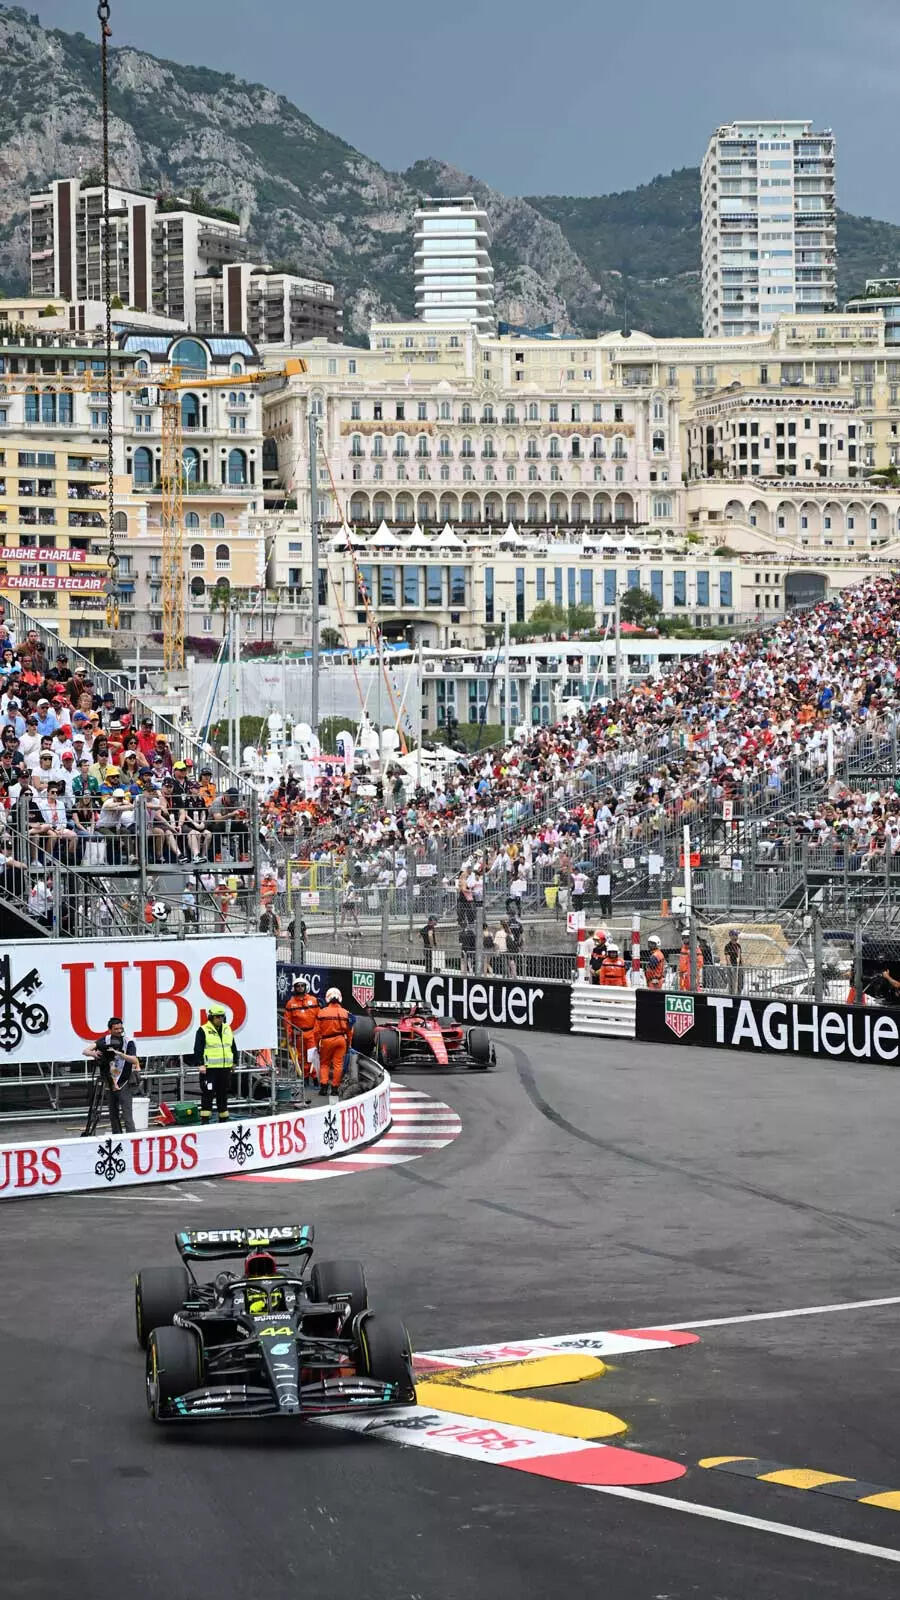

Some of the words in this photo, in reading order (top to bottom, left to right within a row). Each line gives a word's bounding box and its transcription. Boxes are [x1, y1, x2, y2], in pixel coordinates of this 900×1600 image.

[2, 548, 37, 559] DAGHE
[38, 549, 82, 560] CHARLIE
[7, 577, 56, 588] CHARLES
[57, 578, 101, 589] L'ECLAIR
[354, 973, 373, 986] TAG
[61, 956, 246, 1040] UBS
[667, 997, 692, 1012] TAG
[666, 1013, 692, 1035] HEUER
[340, 1103, 365, 1143] UBS
[257, 1117, 307, 1159] UBS
[131, 1132, 198, 1176] UBS
[197, 1226, 293, 1242] PETRONAS
[259, 1326, 294, 1337] 44
[426, 1424, 537, 1451] UBS
